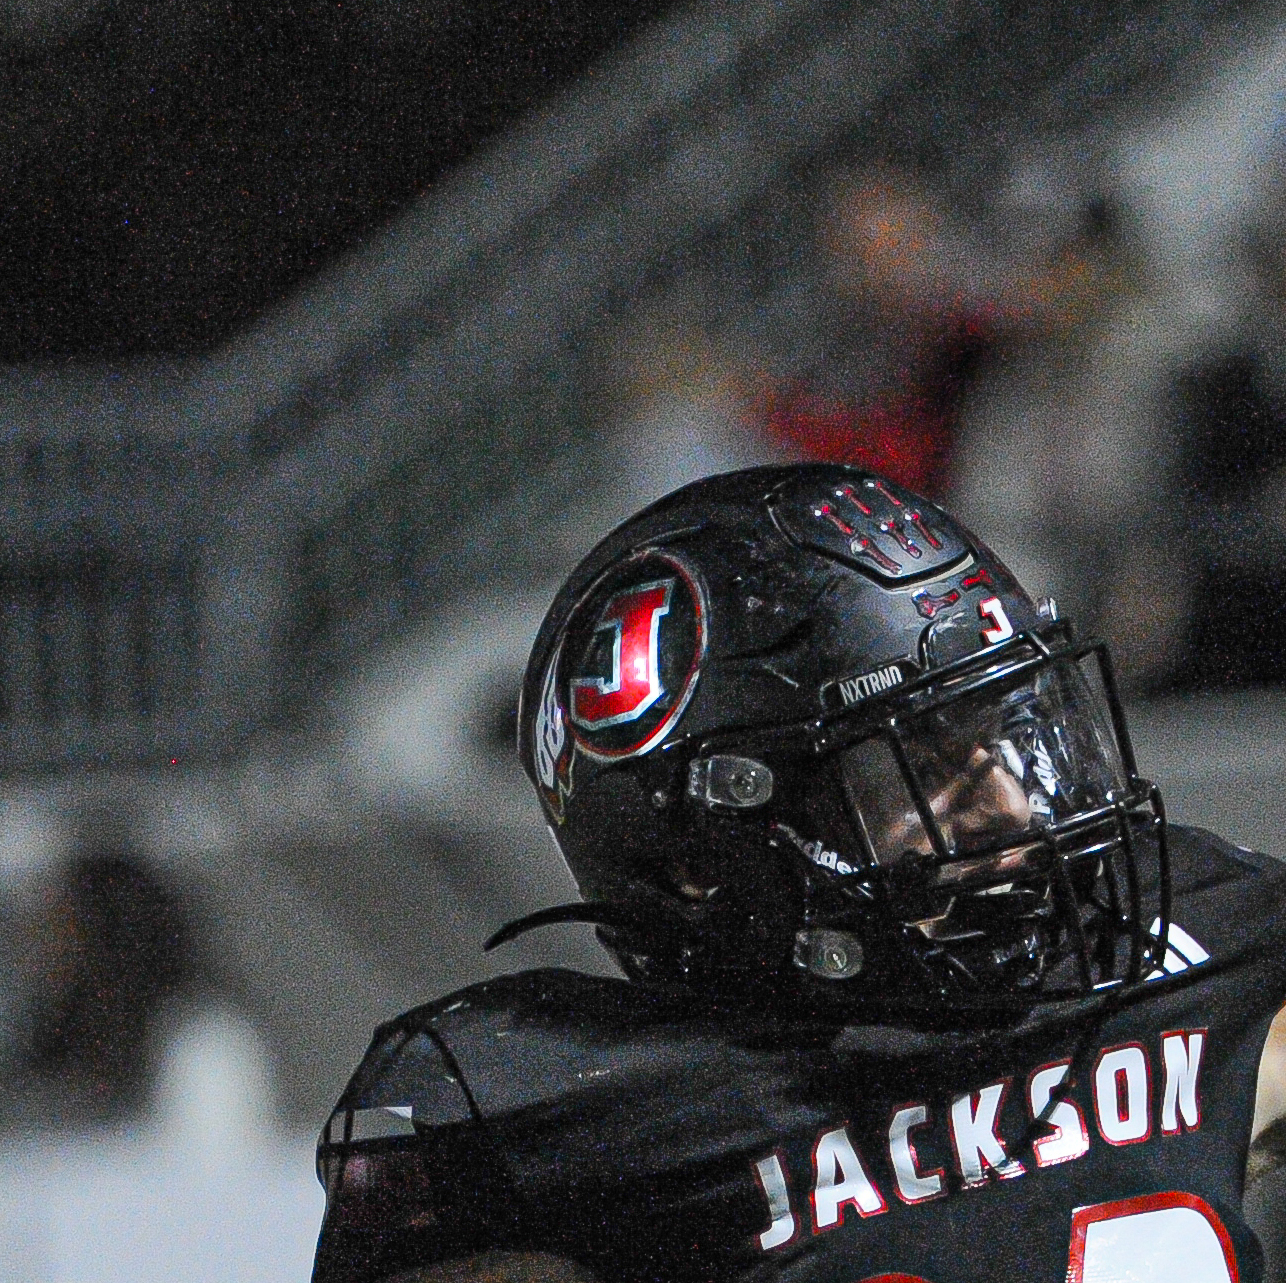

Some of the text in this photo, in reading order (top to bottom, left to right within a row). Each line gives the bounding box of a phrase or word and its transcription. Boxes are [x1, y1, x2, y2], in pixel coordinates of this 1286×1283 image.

[567, 576, 675, 732] J
[980, 597, 1014, 644] J
[753, 1027, 1208, 1251] JACKSON
